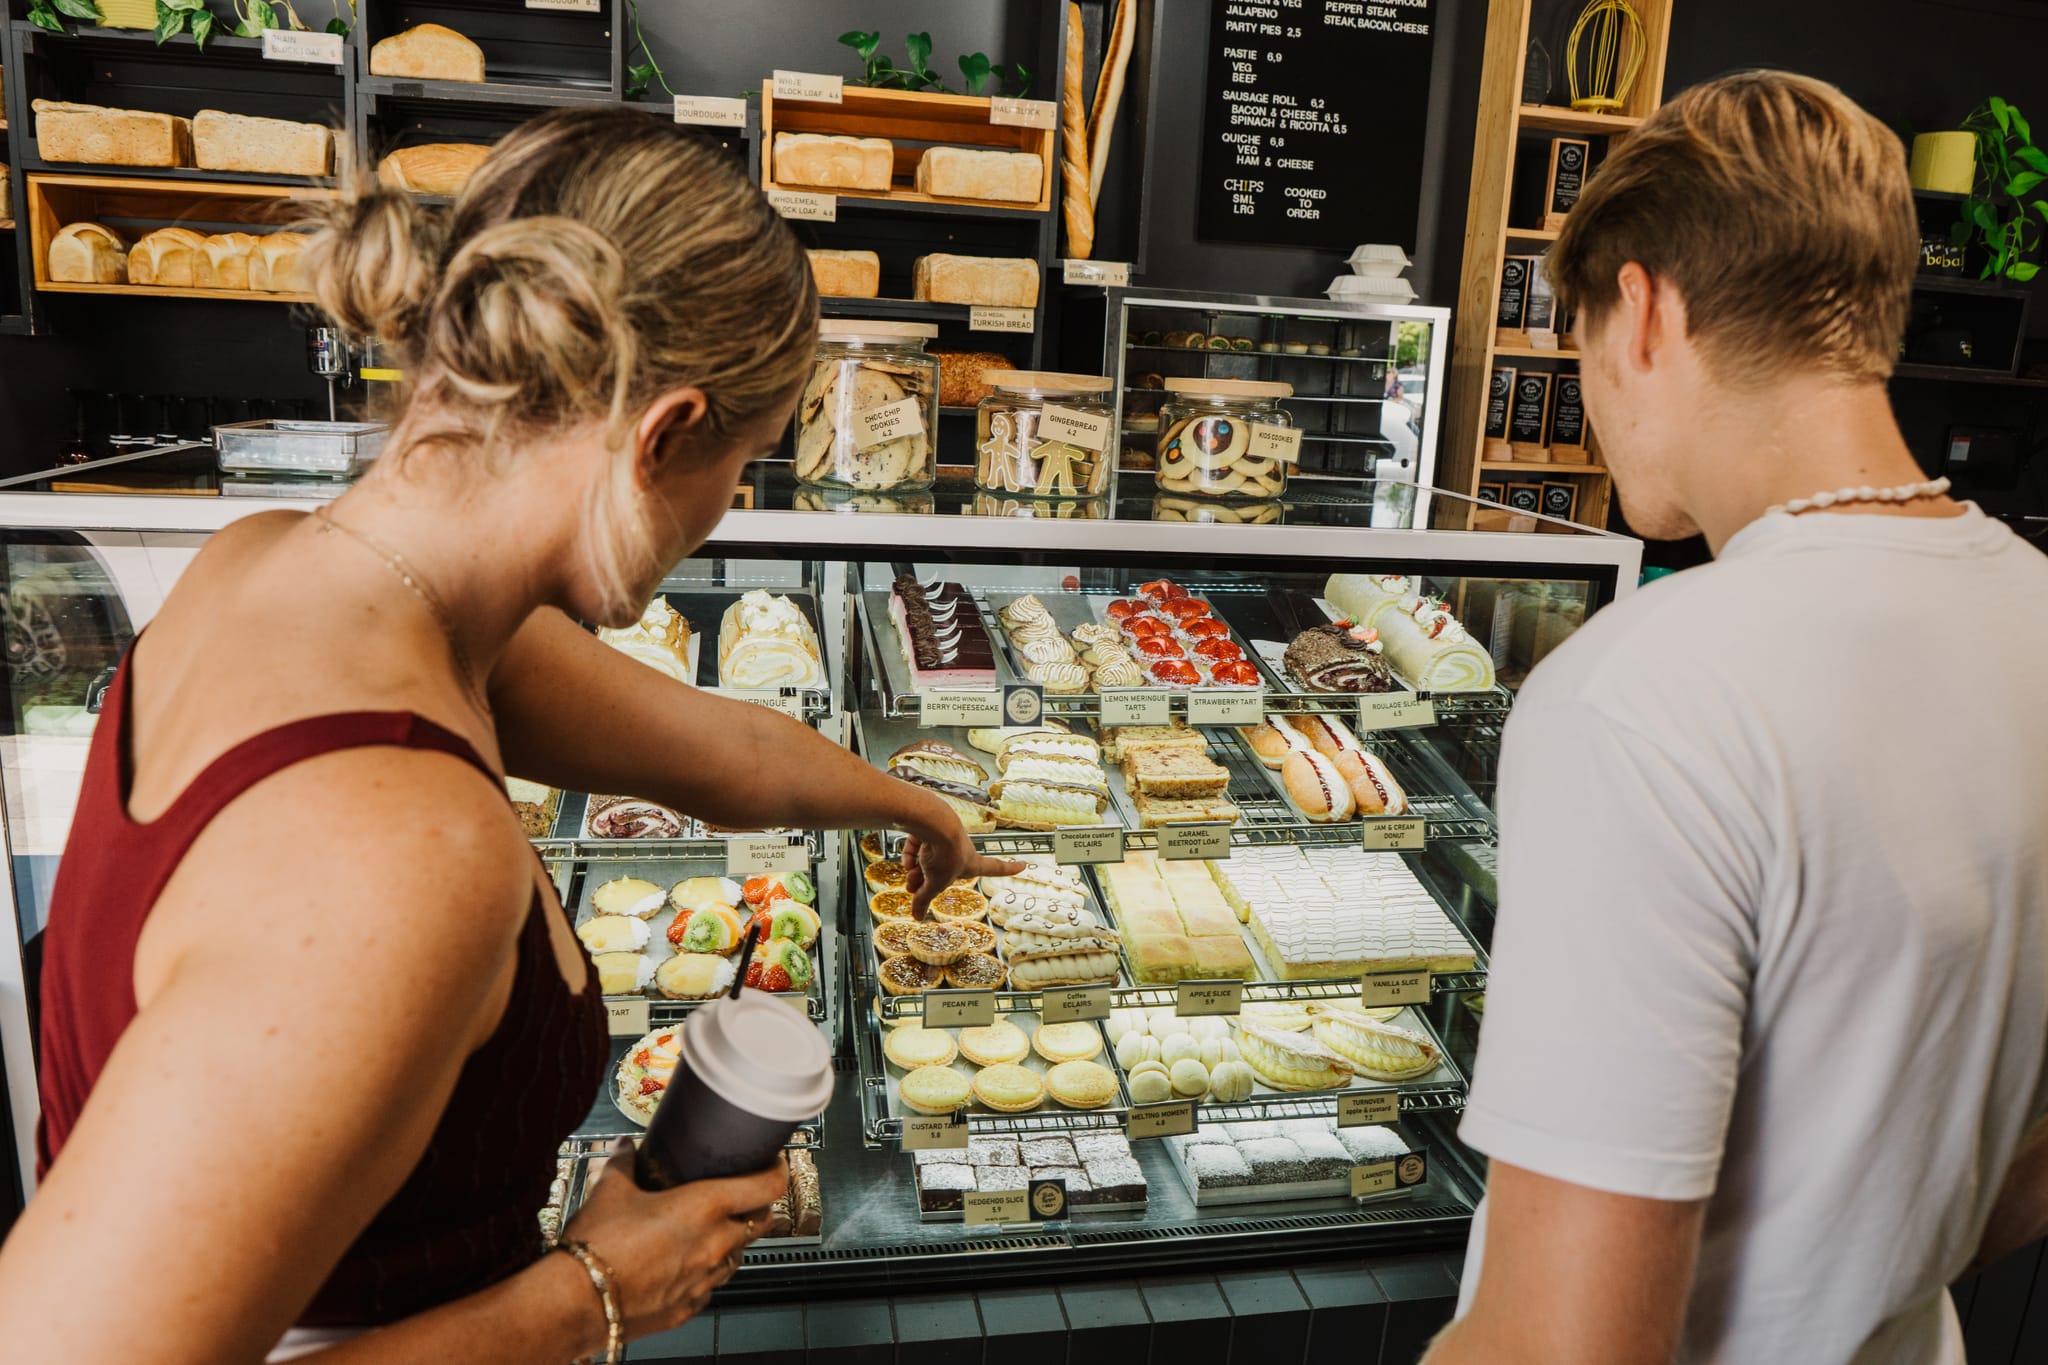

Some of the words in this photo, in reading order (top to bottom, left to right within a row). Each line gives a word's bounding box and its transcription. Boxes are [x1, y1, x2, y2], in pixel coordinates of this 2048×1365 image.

[1226, 5, 1278, 19] JALAPENO
[1326, 1, 1364, 14] PEPPER
[1367, 6, 1397, 18] STEAK
[1226, 21, 1258, 33] PARTY
[1260, 24, 1282, 36] PIES
[1224, 48, 1258, 60] PASTIE
[1232, 62, 1252, 72] VEG
[1232, 72, 1257, 84] BEEF
[779, 88, 802, 96] BLOCK
[1223, 90, 1269, 104] SAUSAGE
[1273, 95, 1298, 106] ROLL
[677, 109, 726, 119] SOURDOUGH
[1232, 104, 1267, 116] BACON
[1271, 108, 1277, 117] &
[1280, 109, 1318, 121] CHEESE
[1231, 115, 1276, 128] SPINACH
[1280, 119, 1287, 128] &
[1290, 120, 1330, 132] RICOTTA
[1222, 133, 1261, 145] QUICHE
[1238, 144, 1258, 155] VEG
[1237, 155, 1260, 166] HAM
[1265, 157, 1272, 166] &
[1278, 159, 1314, 170] CHEESE
[1224, 179, 1264, 192] CHIPS
[1233, 194, 1255, 204] SML
[1285, 188, 1327, 199] COOKED
[774, 197, 819, 206] WHOLEMEAL
[1299, 199, 1312, 208] TO
[1234, 204, 1254, 214] LRG
[1287, 208, 1320, 219] ORDER
[865, 412, 883, 423] CHOC
[884, 408, 901, 418] CHIP
[870, 418, 900, 432] COOKIES
[1050, 415, 1098, 432] GINGERBREAD
[1272, 434, 1293, 443] COOKIES
[741, 698, 787, 707] ERINGUE
[952, 704, 999, 712] CHEESECAKE
[752, 852, 785, 860] ROULADE
[1063, 1001, 1092, 1009] ECLAIRS
[1352, 1098, 1384, 1106] TURNOVER
[1132, 1112, 1160, 1120] MELTING
[1161, 1109, 1189, 1118] MOMENT
[1362, 1169, 1394, 1180] LAMINGTON
[968, 1198, 1004, 1206] HEDGEHOG
[1006, 1196, 1024, 1204] SLICE
